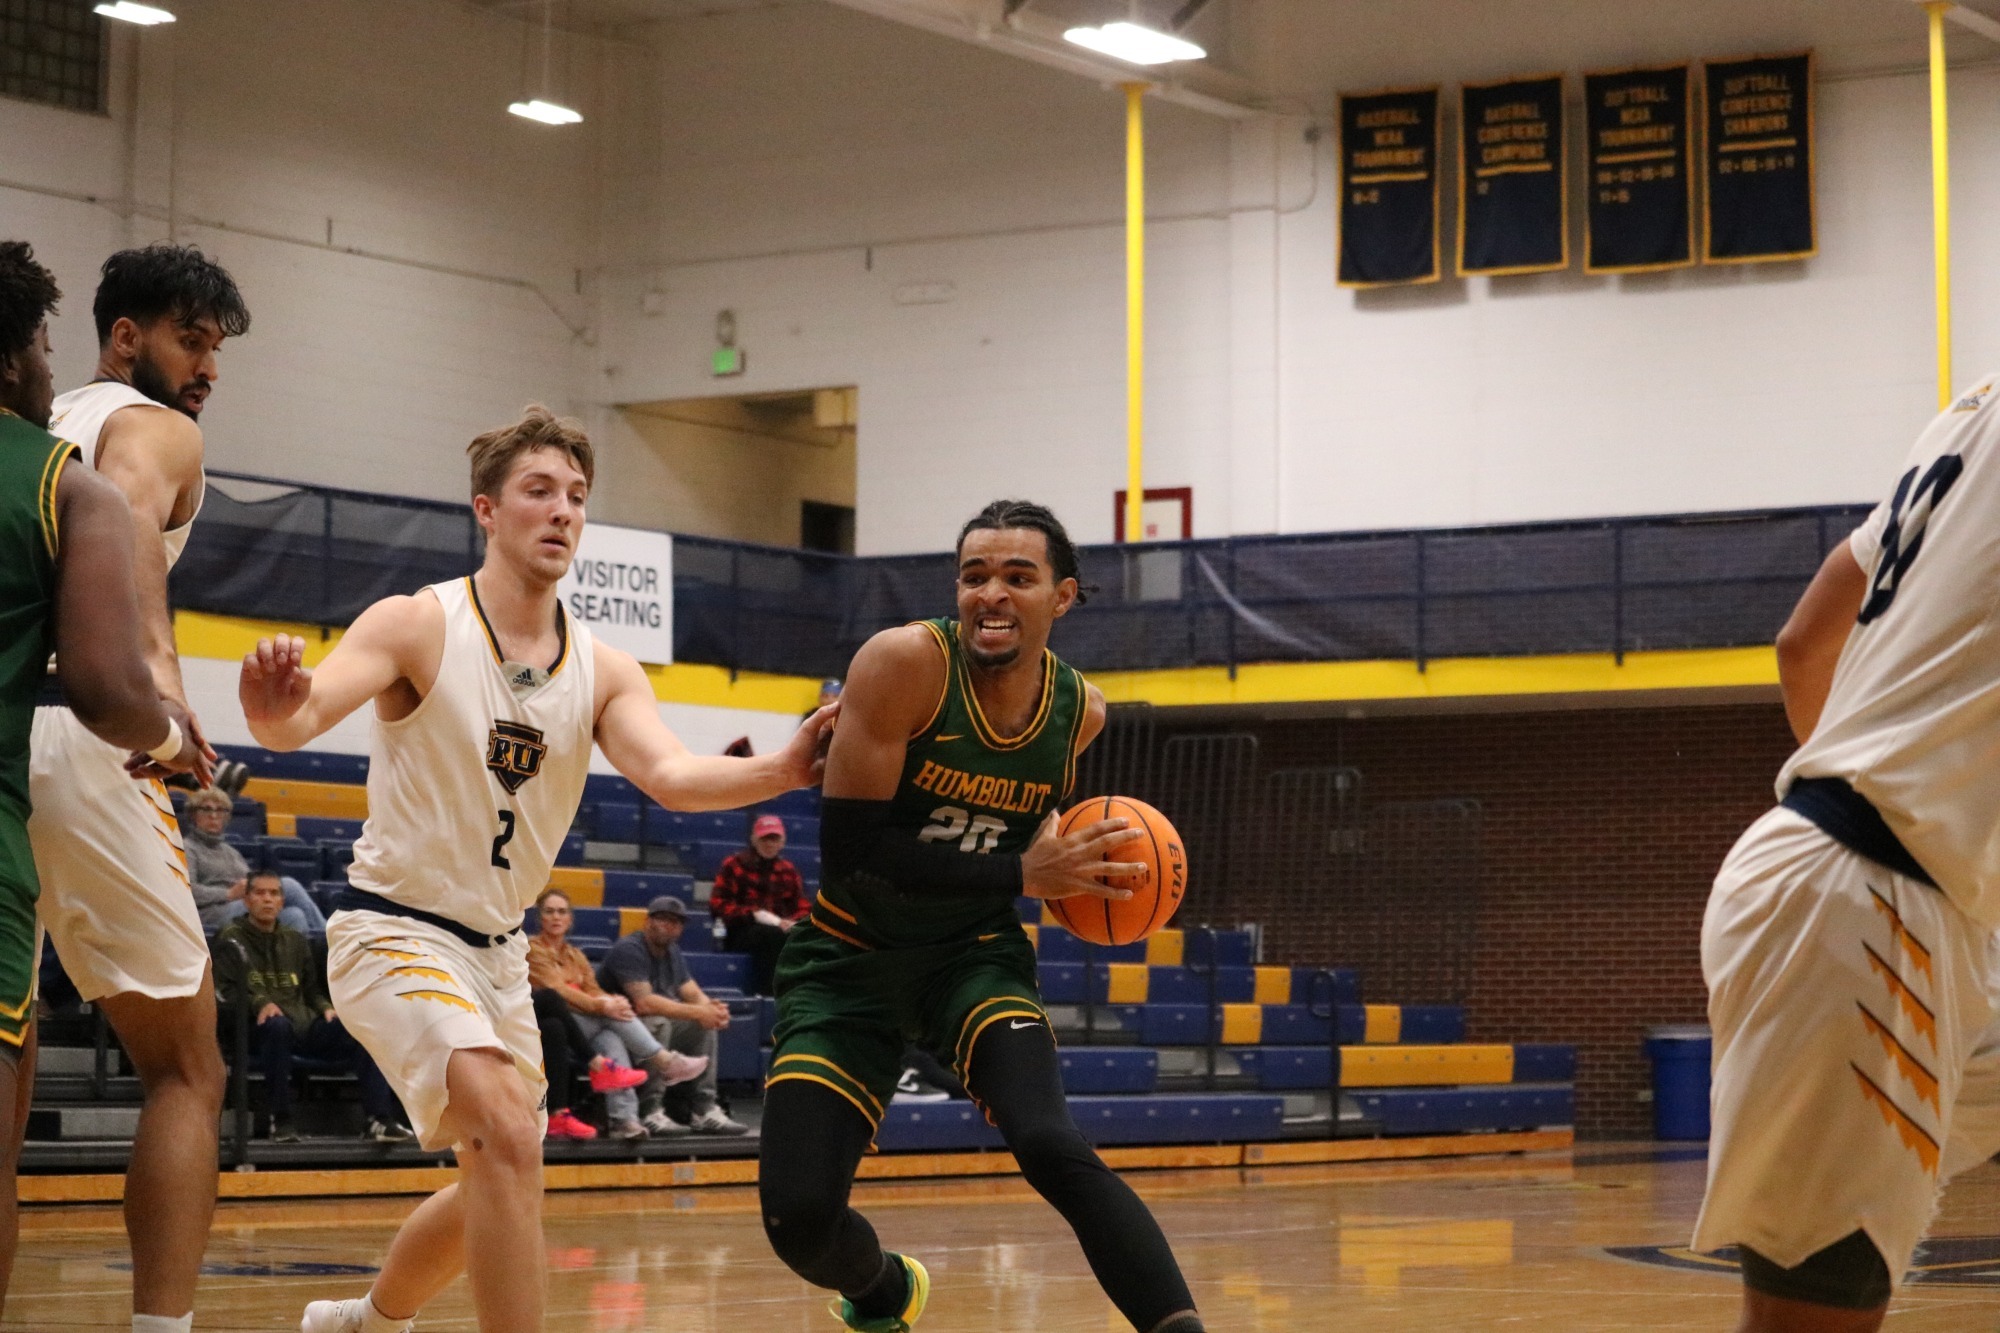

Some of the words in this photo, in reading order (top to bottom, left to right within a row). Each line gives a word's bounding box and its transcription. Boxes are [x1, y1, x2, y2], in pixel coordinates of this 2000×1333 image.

[573, 558, 659, 594] VISITOR
[570, 593, 661, 628] SEATING
[512, 677, 536, 688] adidas
[486, 728, 548, 777] RU
[912, 759, 1053, 815] HUMBOLDT
[491, 809, 515, 870] 2
